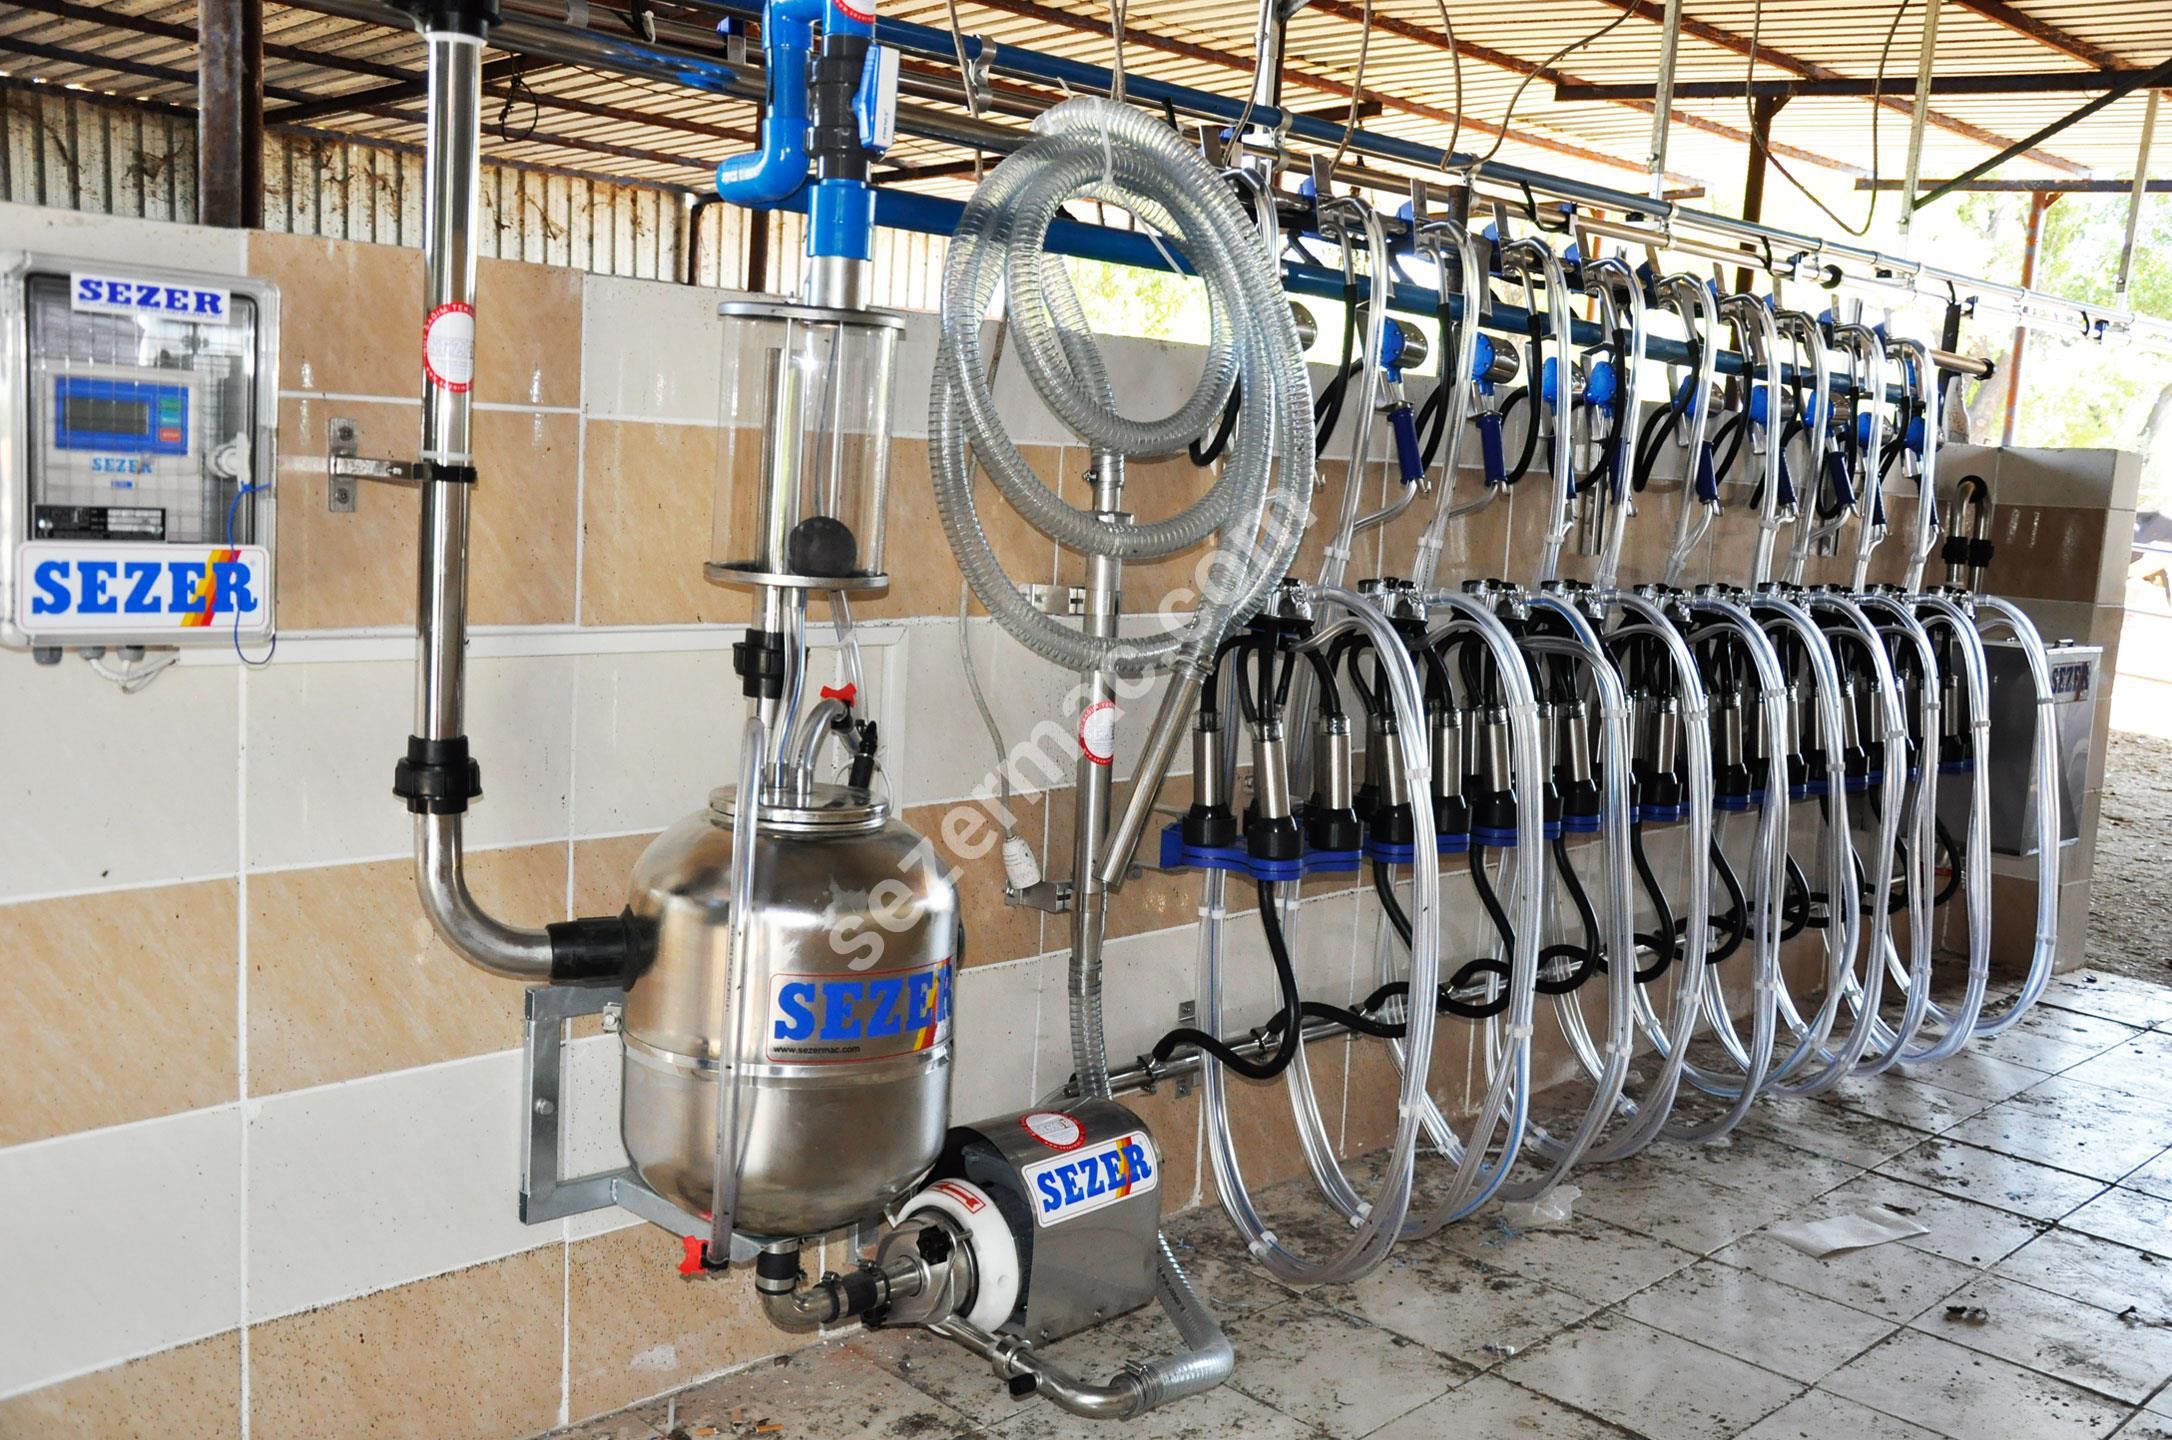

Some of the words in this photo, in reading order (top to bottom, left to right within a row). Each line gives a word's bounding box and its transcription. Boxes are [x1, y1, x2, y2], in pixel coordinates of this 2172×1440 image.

[78, 279, 223, 315] SEZER
[92, 457, 152, 474] SEZER
[32, 560, 258, 615] SEZER
[2051, 663, 2089, 694] SEZER
[773, 1046, 861, 1055] www.sezermac.com
[1037, 1144, 1153, 1214] SEZER
